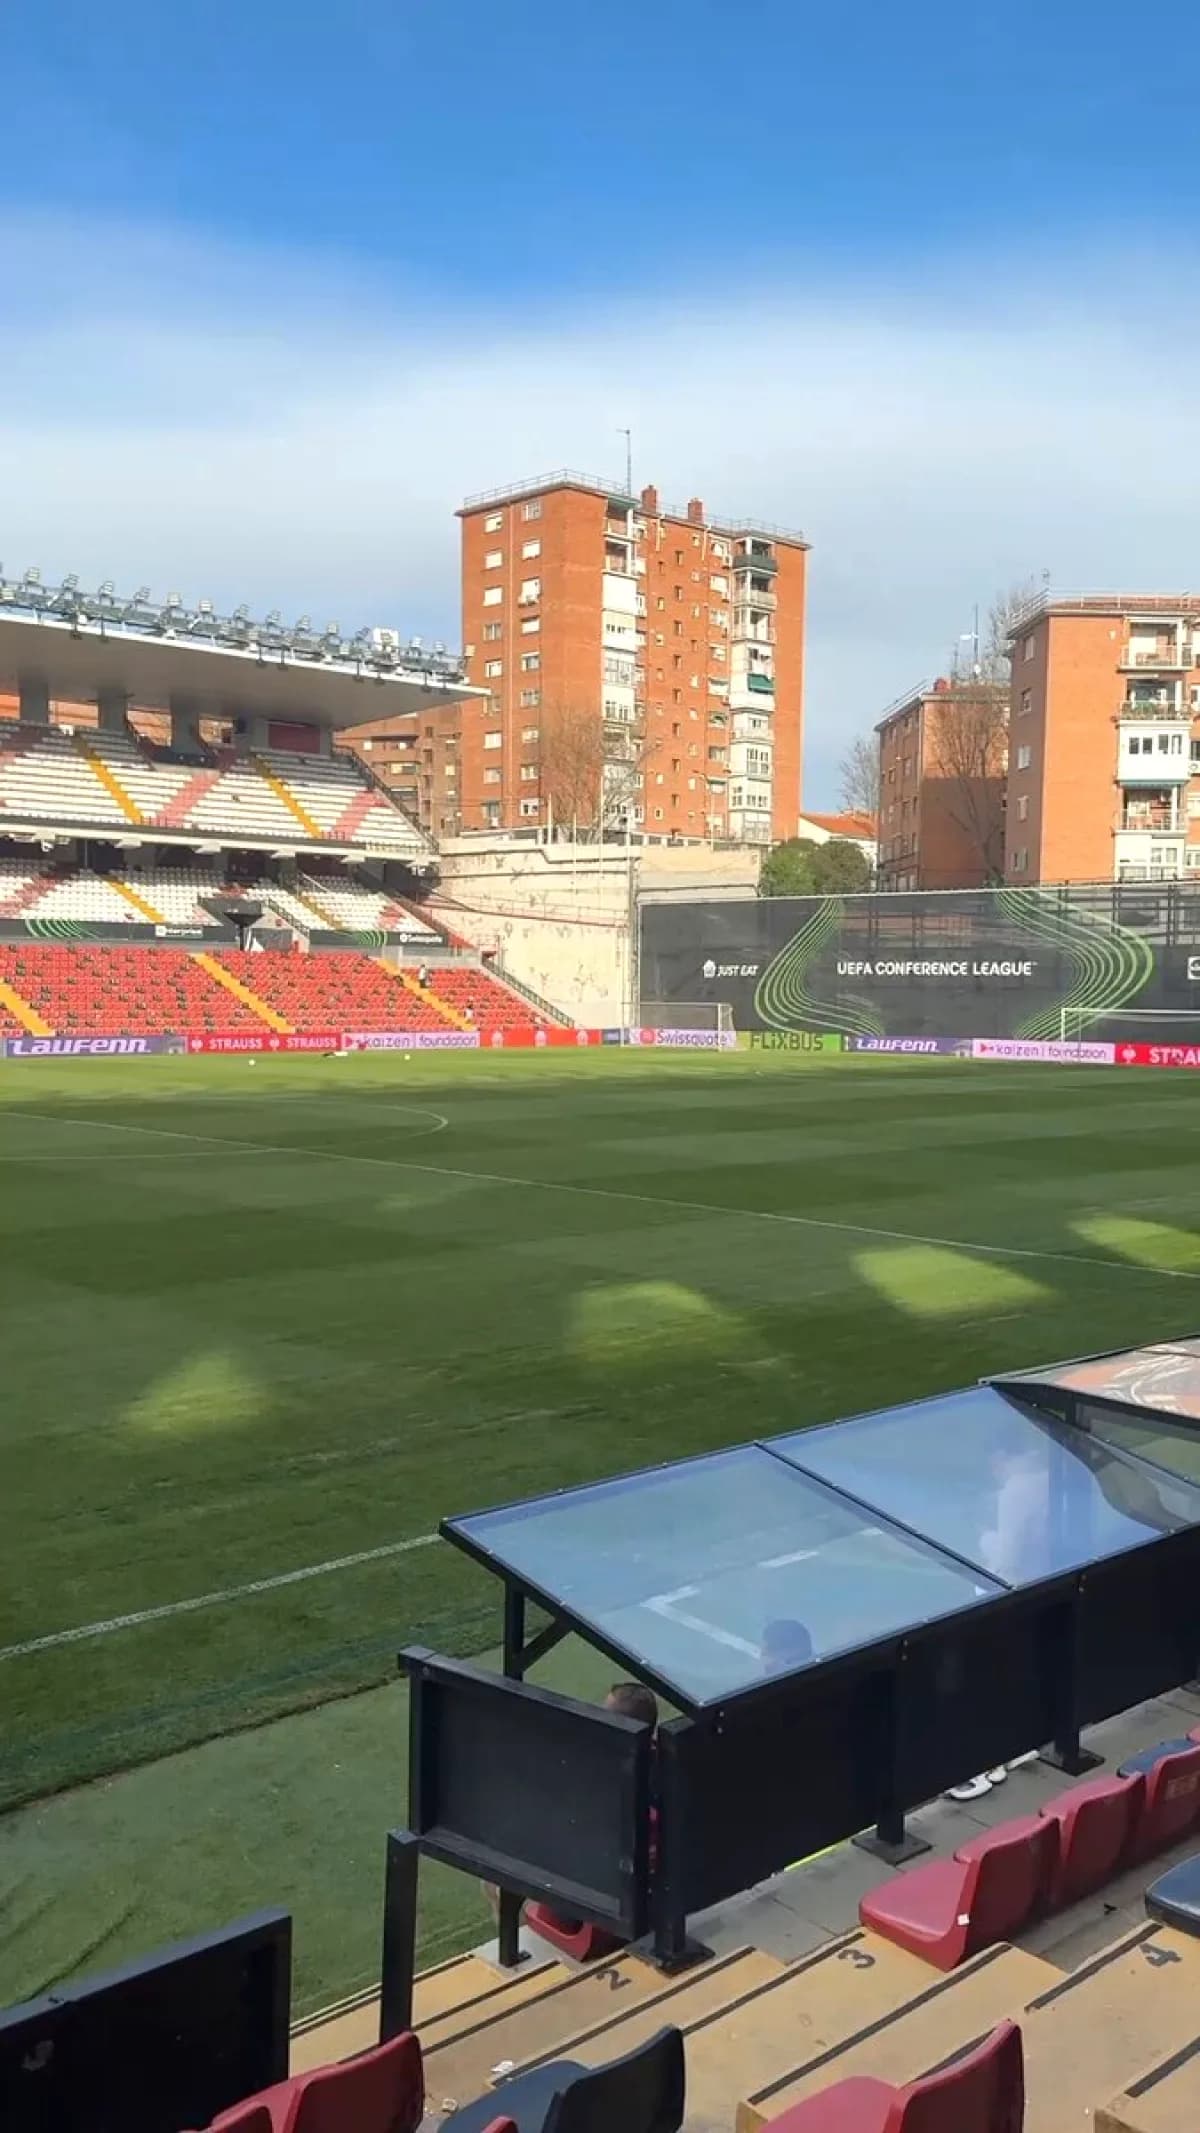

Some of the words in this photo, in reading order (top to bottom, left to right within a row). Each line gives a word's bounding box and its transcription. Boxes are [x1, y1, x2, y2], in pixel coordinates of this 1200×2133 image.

[717, 965, 740, 977] JUST
[740, 964, 759, 977] EAT
[837, 962, 873, 975] UEFA
[875, 962, 968, 976] CONFERENCE
[209, 1037, 263, 1049] STRAUSS
[286, 1037, 337, 1049] STRAUSS
[364, 1035, 411, 1048] kaizen
[419, 1034, 477, 1047] foundation
[656, 1029, 728, 1046] Swissquote
[996, 1045, 1039, 1057] kaizen
[1149, 1047, 1200, 1065] STRA
[837, 1950, 876, 1969] 3
[1140, 1943, 1183, 1967] 4
[596, 1969, 632, 1991] 2
